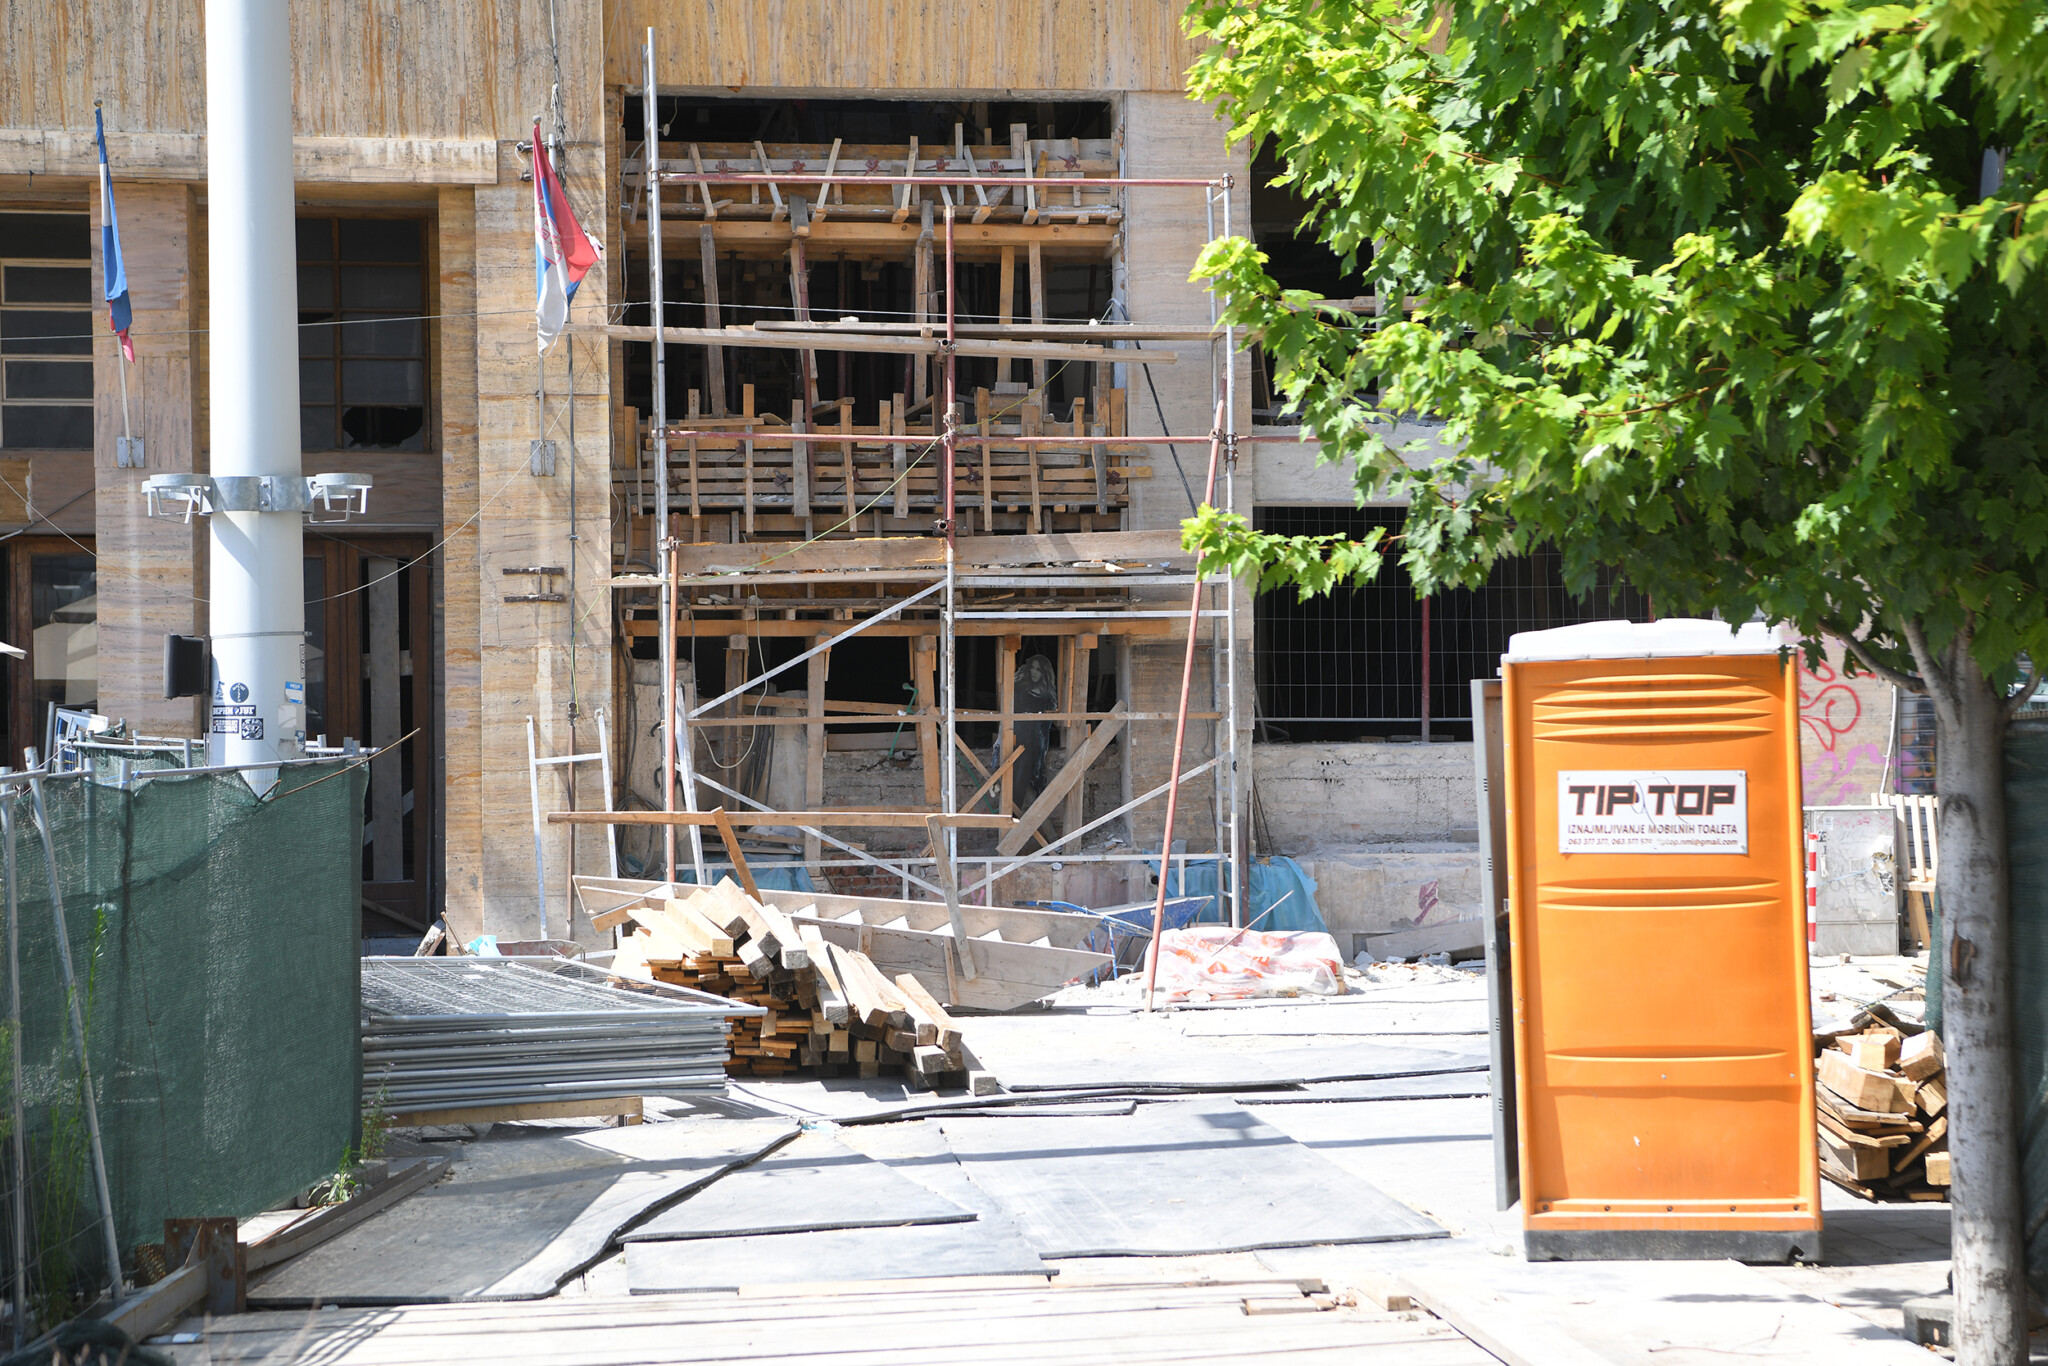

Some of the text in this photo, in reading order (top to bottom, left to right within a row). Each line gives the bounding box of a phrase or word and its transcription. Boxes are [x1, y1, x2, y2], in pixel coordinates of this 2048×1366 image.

[1568, 785, 1737, 816] TIP TOP
[1568, 824, 1738, 834] IZNAJMLJIVANJE MOBILNIH TOALETA
